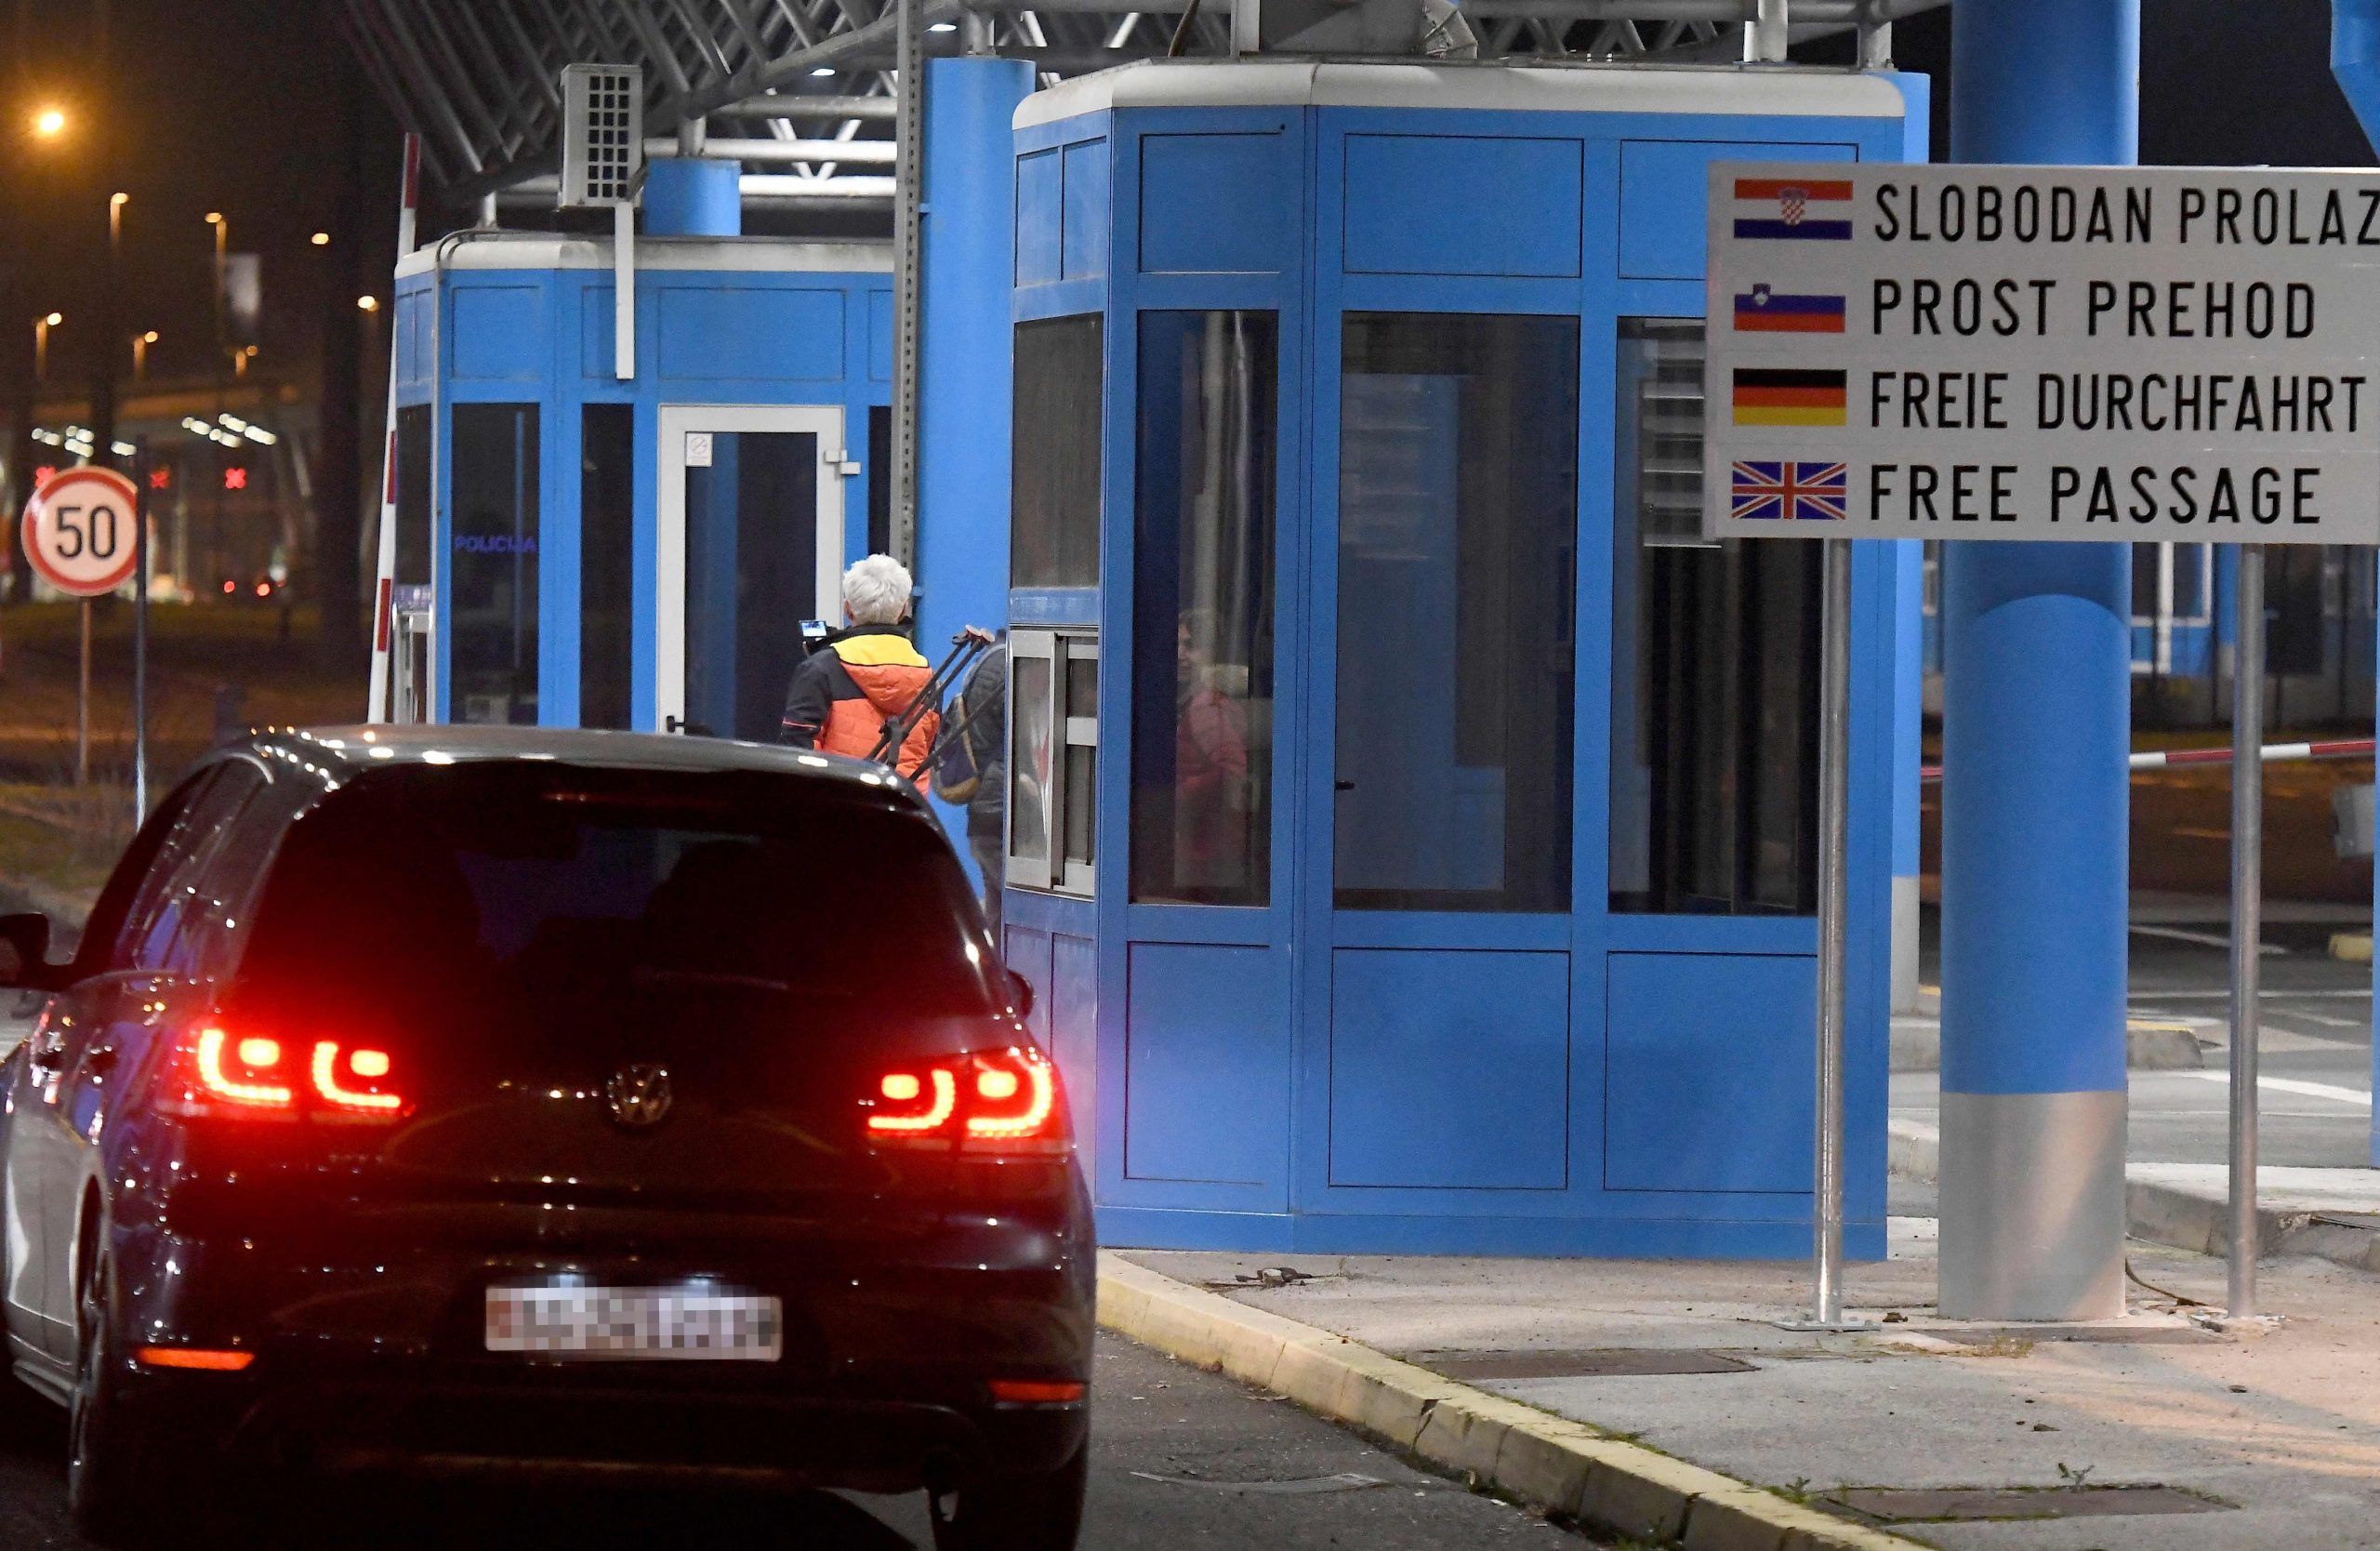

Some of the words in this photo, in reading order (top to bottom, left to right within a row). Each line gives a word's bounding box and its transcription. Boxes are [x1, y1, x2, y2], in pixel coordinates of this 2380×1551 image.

[1875, 183, 2152, 244] SLOBODAN
[2179, 188, 2380, 245] PROLAZ
[1873, 278, 2057, 337] PROST
[2088, 281, 2315, 339] PREHOD
[1871, 372, 2009, 430] FREIE
[2038, 373, 2366, 433] DURCHFAHRT
[1871, 465, 2018, 523] FREE
[2051, 466, 2321, 525] PASSAGE
[57, 506, 116, 559] 50
